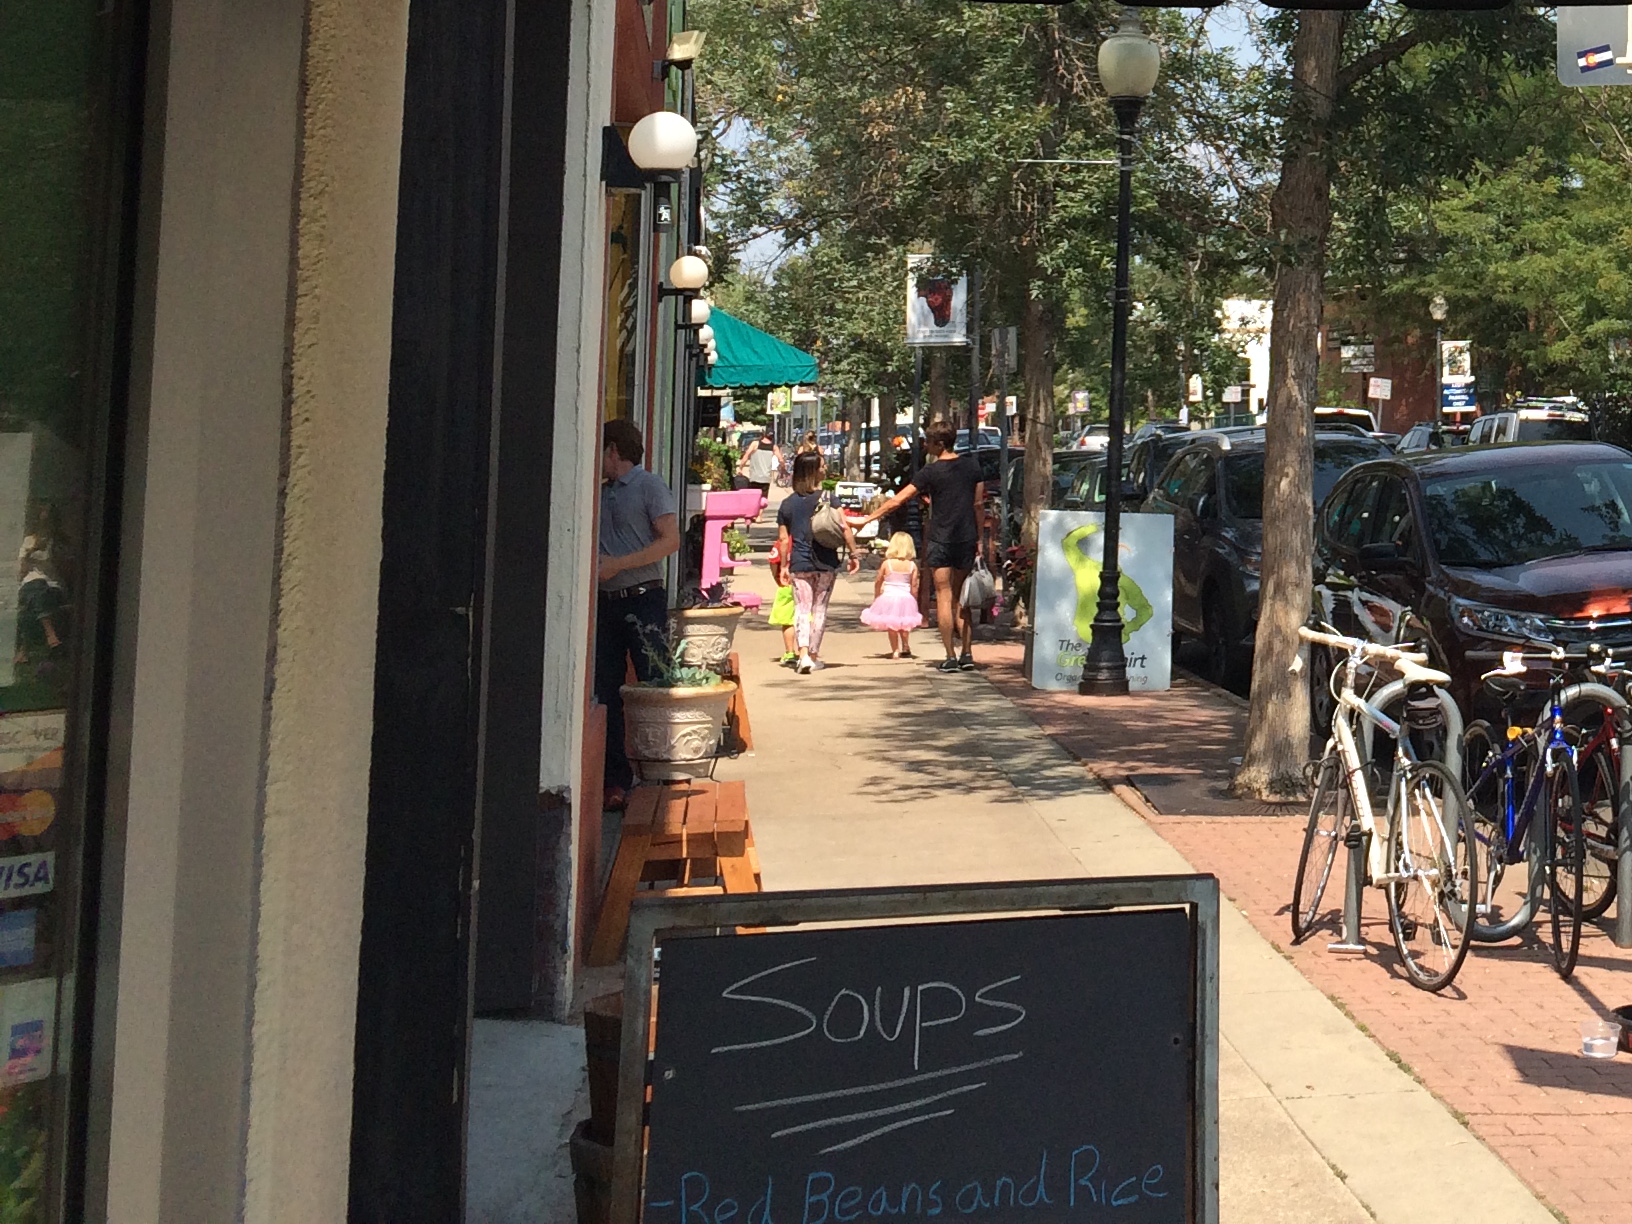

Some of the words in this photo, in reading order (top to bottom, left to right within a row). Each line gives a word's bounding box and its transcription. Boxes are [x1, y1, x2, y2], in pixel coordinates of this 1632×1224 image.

[1059, 639, 1082, 652] The
[1056, 651, 1086, 668] Gre
[803, 1171, 943, 1224] Beans
[955, 1147, 1056, 1215] and
[1069, 1145, 1169, 1208] Rice
